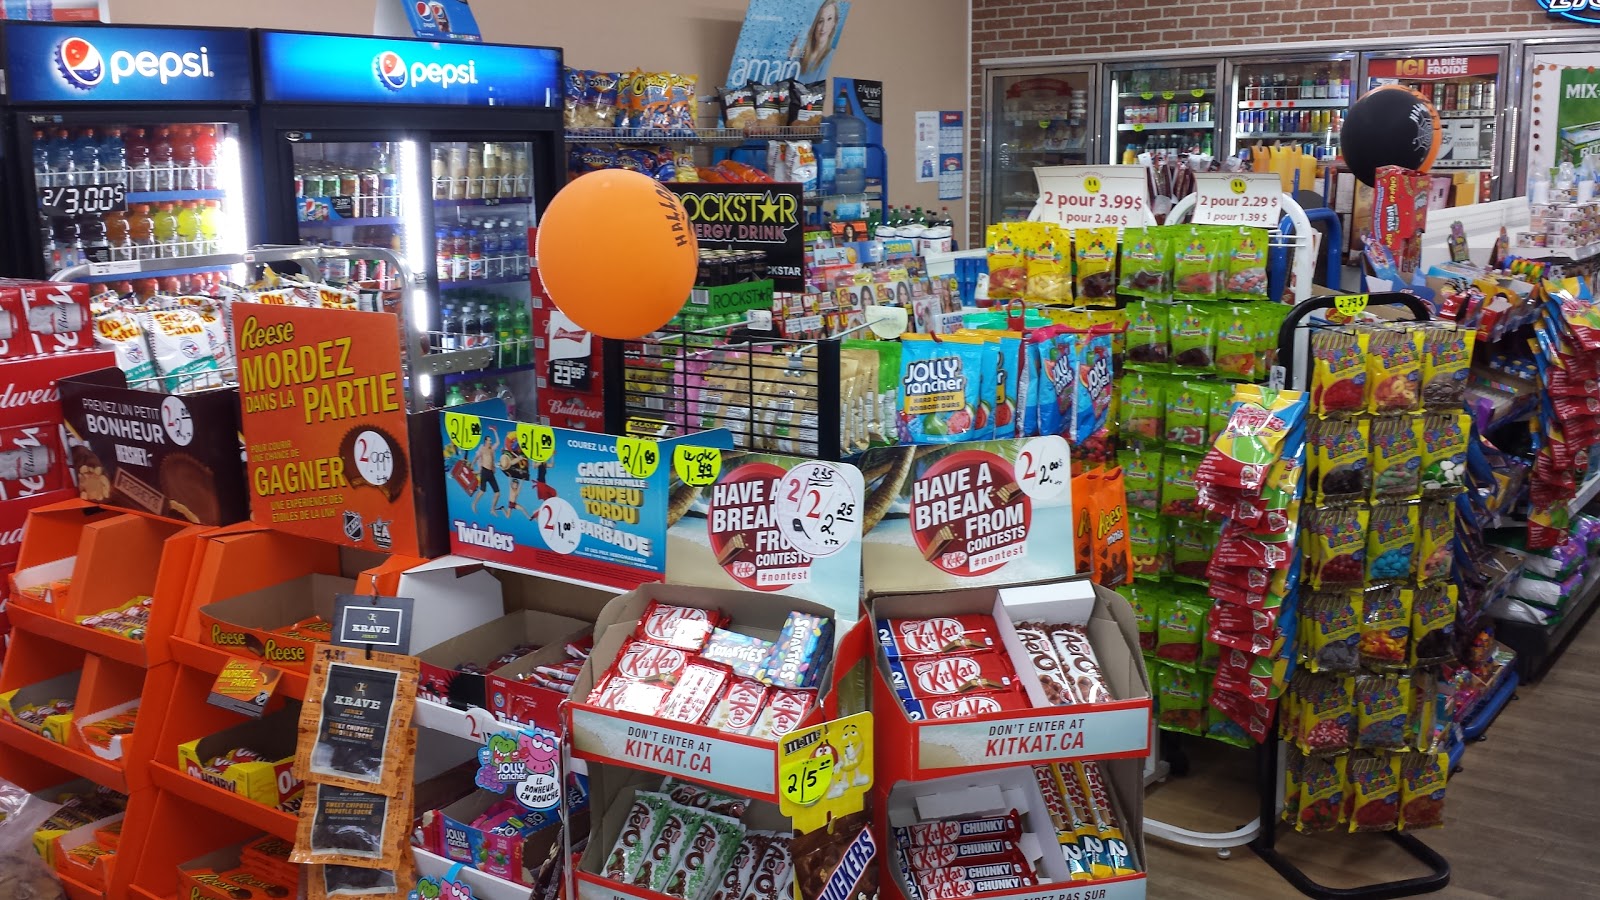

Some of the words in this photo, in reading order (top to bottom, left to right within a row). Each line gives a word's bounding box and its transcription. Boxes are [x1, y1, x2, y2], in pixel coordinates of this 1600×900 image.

[110, 46, 211, 84] pepsi
[1396, 59, 1424, 76] ICI
[1427, 59, 1439, 67] LA
[1442, 57, 1468, 66] BIÈRE
[1427, 65, 1468, 75] FROIDE
[411, 60, 477, 88] pepsi
[1045, 192, 1053, 204] 2
[1058, 193, 1094, 210] pour
[1099, 194, 1142, 210] 3.99$
[1201, 196, 1208, 206] 2
[1211, 197, 1237, 210] pour
[1242, 196, 1268, 207] 2.29
[1272, 197, 1278, 208] $
[1058, 211, 1063, 221] 1
[1067, 213, 1092, 224] pour
[1095, 213, 1118, 224] 2.49
[1121, 214, 1127, 226] $
[1214, 213, 1235, 223] pour
[1239, 212, 1259, 222] 1.39
[738, 224, 785, 240] DRINK
[241, 315, 295, 351] Reese
[242, 336, 355, 393] MORDEZ
[905, 359, 960, 384] JOLLY
[906, 378, 963, 395] rancher
[82, 398, 118, 414] PRENEZ
[119, 403, 133, 416] UN
[134, 405, 160, 420] PETIT
[245, 394, 278, 413] DANS
[280, 389, 296, 409] LA
[303, 372, 399, 424] PARTIE
[548, 399, 602, 418] Budweiser
[164, 404, 175, 427] 2
[86, 413, 166, 445] BONHEUR
[358, 438, 369, 462] 2
[567, 439, 597, 450] COUREZ
[598, 444, 608, 453] LA
[254, 456, 347, 496] GAGNER
[1018, 451, 1036, 480] 2
[713, 478, 764, 507] HAVE
[769, 478, 782, 501] A
[787, 478, 800, 502] 2
[914, 470, 970, 504] HAVE
[976, 462, 992, 487] A
[581, 485, 642, 507] #UNPEU
[806, 489, 822, 519] 2
[543, 504, 554, 530] 2
[584, 500, 638, 524] TORDU
[916, 486, 994, 530] BREAK
[965, 503, 1024, 540] FROM
[455, 520, 514, 553] Twizzlers
[580, 519, 652, 557] BARBADE
[967, 525, 1026, 554] CONTESTS
[756, 552, 811, 567] CONTESTS
[974, 548, 1023, 567] #nontest
[761, 571, 807, 582] #nontest
[211, 623, 247, 646] Reese
[352, 624, 390, 634] KRAVE
[879, 628, 890, 640] 2
[914, 619, 960, 648] KitKat
[264, 639, 305, 661] Reese
[705, 642, 767, 664] SMARTIES
[778, 616, 809, 682] SMARTIES
[625, 649, 678, 673] KitKat
[892, 671, 905, 683] 2
[928, 657, 974, 692] KitKat
[333, 695, 381, 710] KRAVE
[466, 714, 481, 738] 2
[989, 722, 1023, 736] DON'T
[1028, 721, 1064, 732] ENTER
[1069, 718, 1085, 729] AT
[627, 726, 659, 740] DON'T
[662, 733, 695, 750] ENTER
[698, 742, 712, 753] AT
[985, 731, 1084, 757] KITKAT.CA
[625, 738, 712, 774] KITKAT.CA
[497, 763, 526, 774] JOLLY
[498, 773, 527, 781] rancher
[524, 783, 554, 793] BONHEUR
[536, 777, 543, 785] LE
[345, 802, 374, 811] CHIPOTLE
[520, 792, 530, 800] EN
[532, 789, 559, 802] BOUCHE
[325, 807, 352, 815] CHIPOTLE
[446, 827, 466, 840] JOLLY
[922, 821, 959, 845] KitKat
[962, 819, 1004, 835] CHUNKY
[920, 844, 956, 869] KitKat
[960, 841, 1001, 855] CHUNKY
[1083, 837, 1103, 854] 2
[1107, 839, 1127, 857] 2
[816, 828, 876, 900] NICKERS
[926, 866, 963, 885] KitKat
[968, 863, 1010, 878] CHUNKY
[934, 880, 972, 899] KitKat
[976, 877, 1019, 892] CHUNKY
[1084, 889, 1106, 900] SUR
